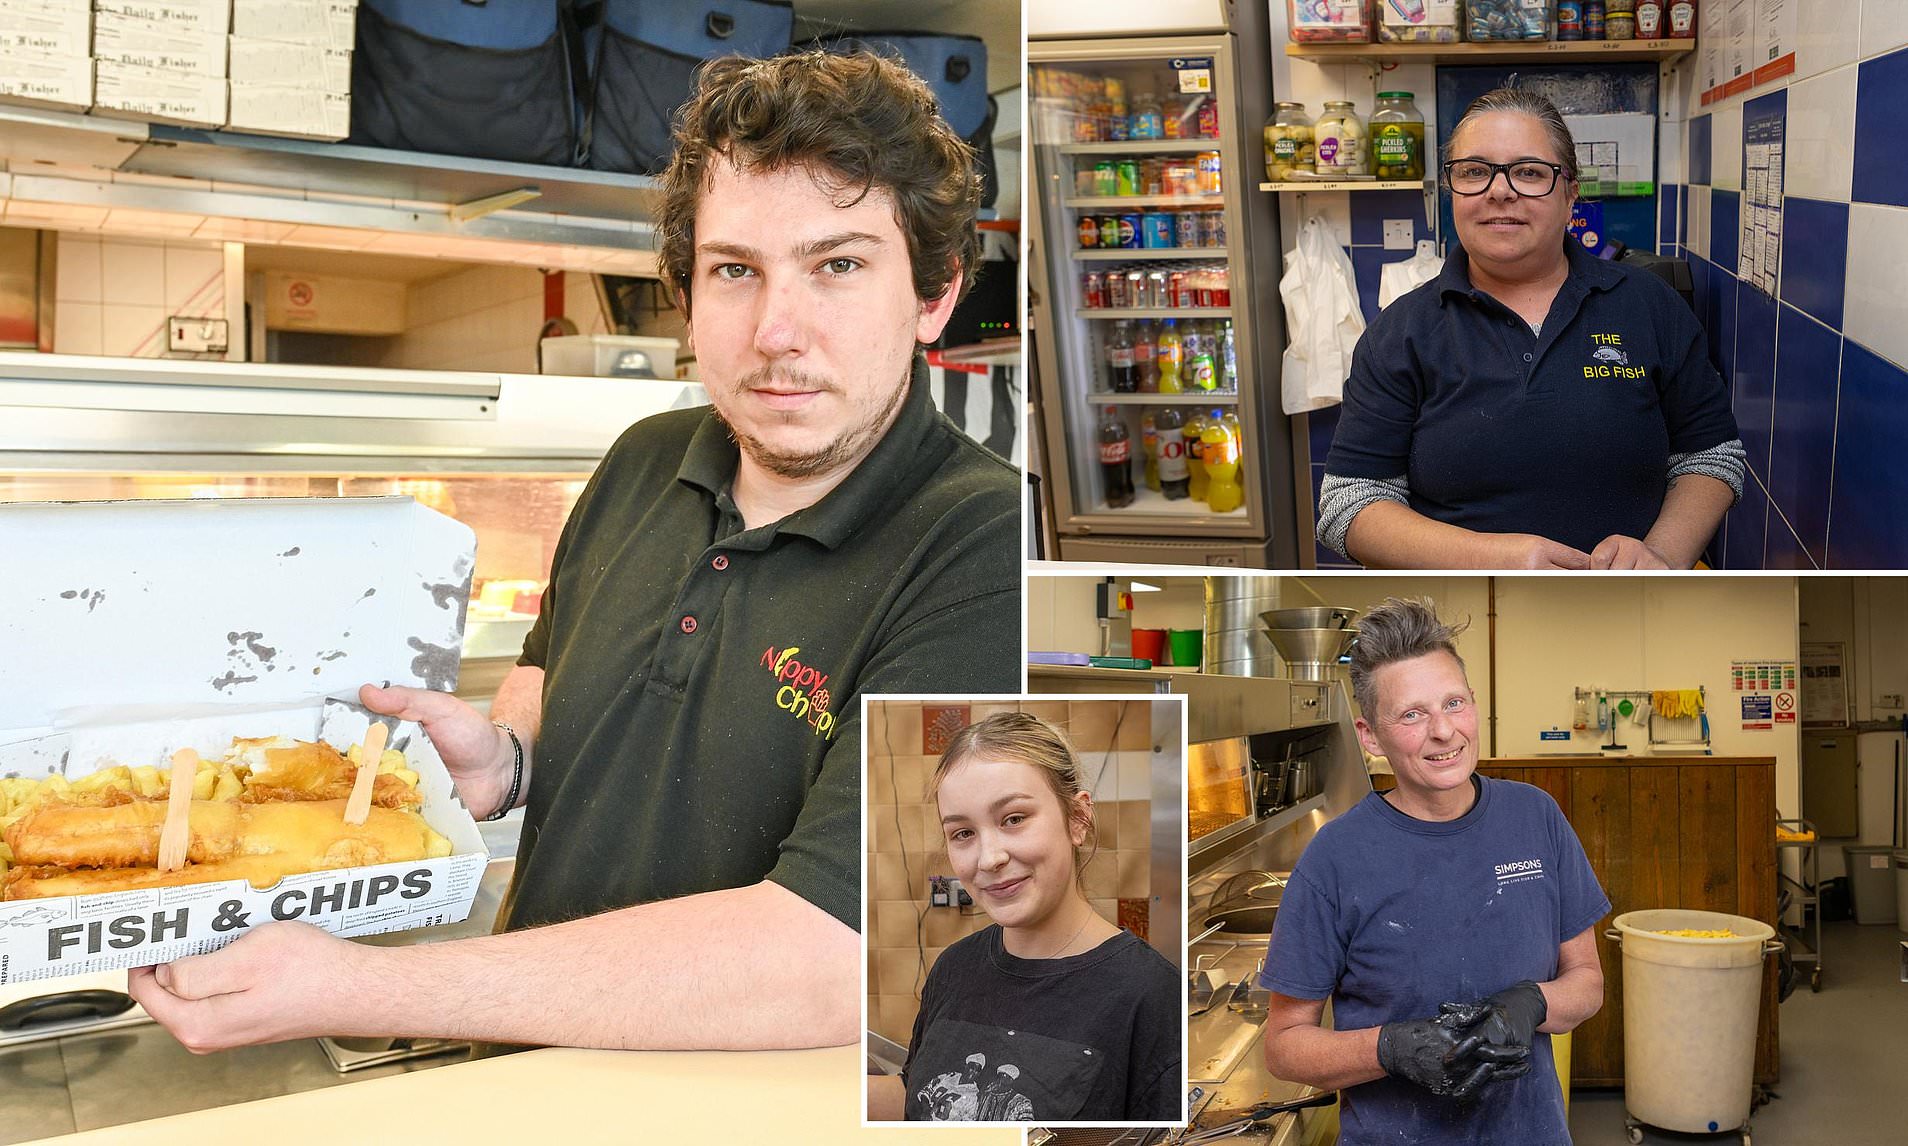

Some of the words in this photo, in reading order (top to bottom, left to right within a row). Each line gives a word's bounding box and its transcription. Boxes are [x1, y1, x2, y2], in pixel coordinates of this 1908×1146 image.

[1590, 333, 1622, 345] THE
[1583, 365, 1611, 379] BIG
[1613, 365, 1646, 379] FISH
[759, 646, 829, 697] Nippy
[1494, 859, 1542, 874] SIMPSONS
[47, 907, 190, 961] FISH
[210, 899, 252, 932] &
[270, 868, 433, 921] CHIPS
